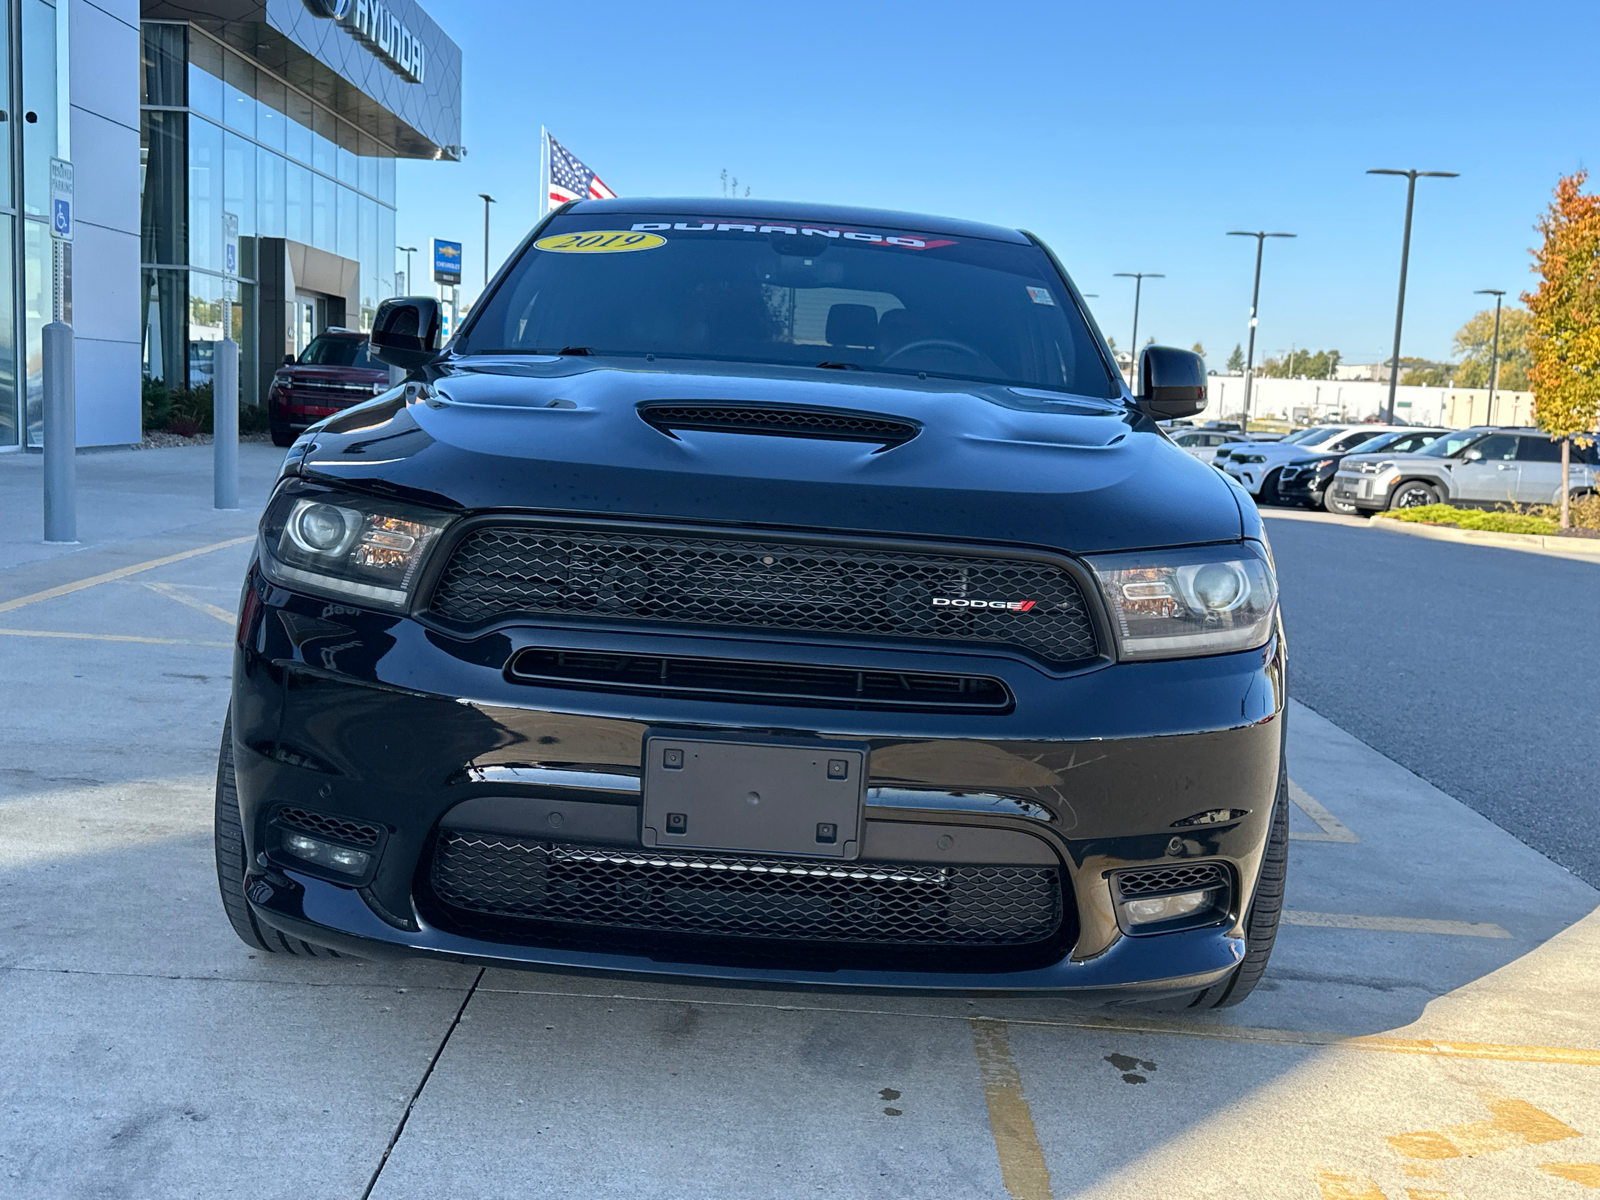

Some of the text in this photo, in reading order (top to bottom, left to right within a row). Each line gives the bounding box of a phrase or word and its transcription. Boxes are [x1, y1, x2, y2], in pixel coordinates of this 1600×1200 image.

[354, 0, 424, 84] HYUNDAI
[51, 164, 72, 180] RESERVED
[51, 179, 72, 195] PARKING
[553, 233, 647, 249] 2019
[630, 222, 926, 248] DURANGO
[436, 261, 460, 270] CHEVROLET
[932, 597, 1023, 610] DODGE
